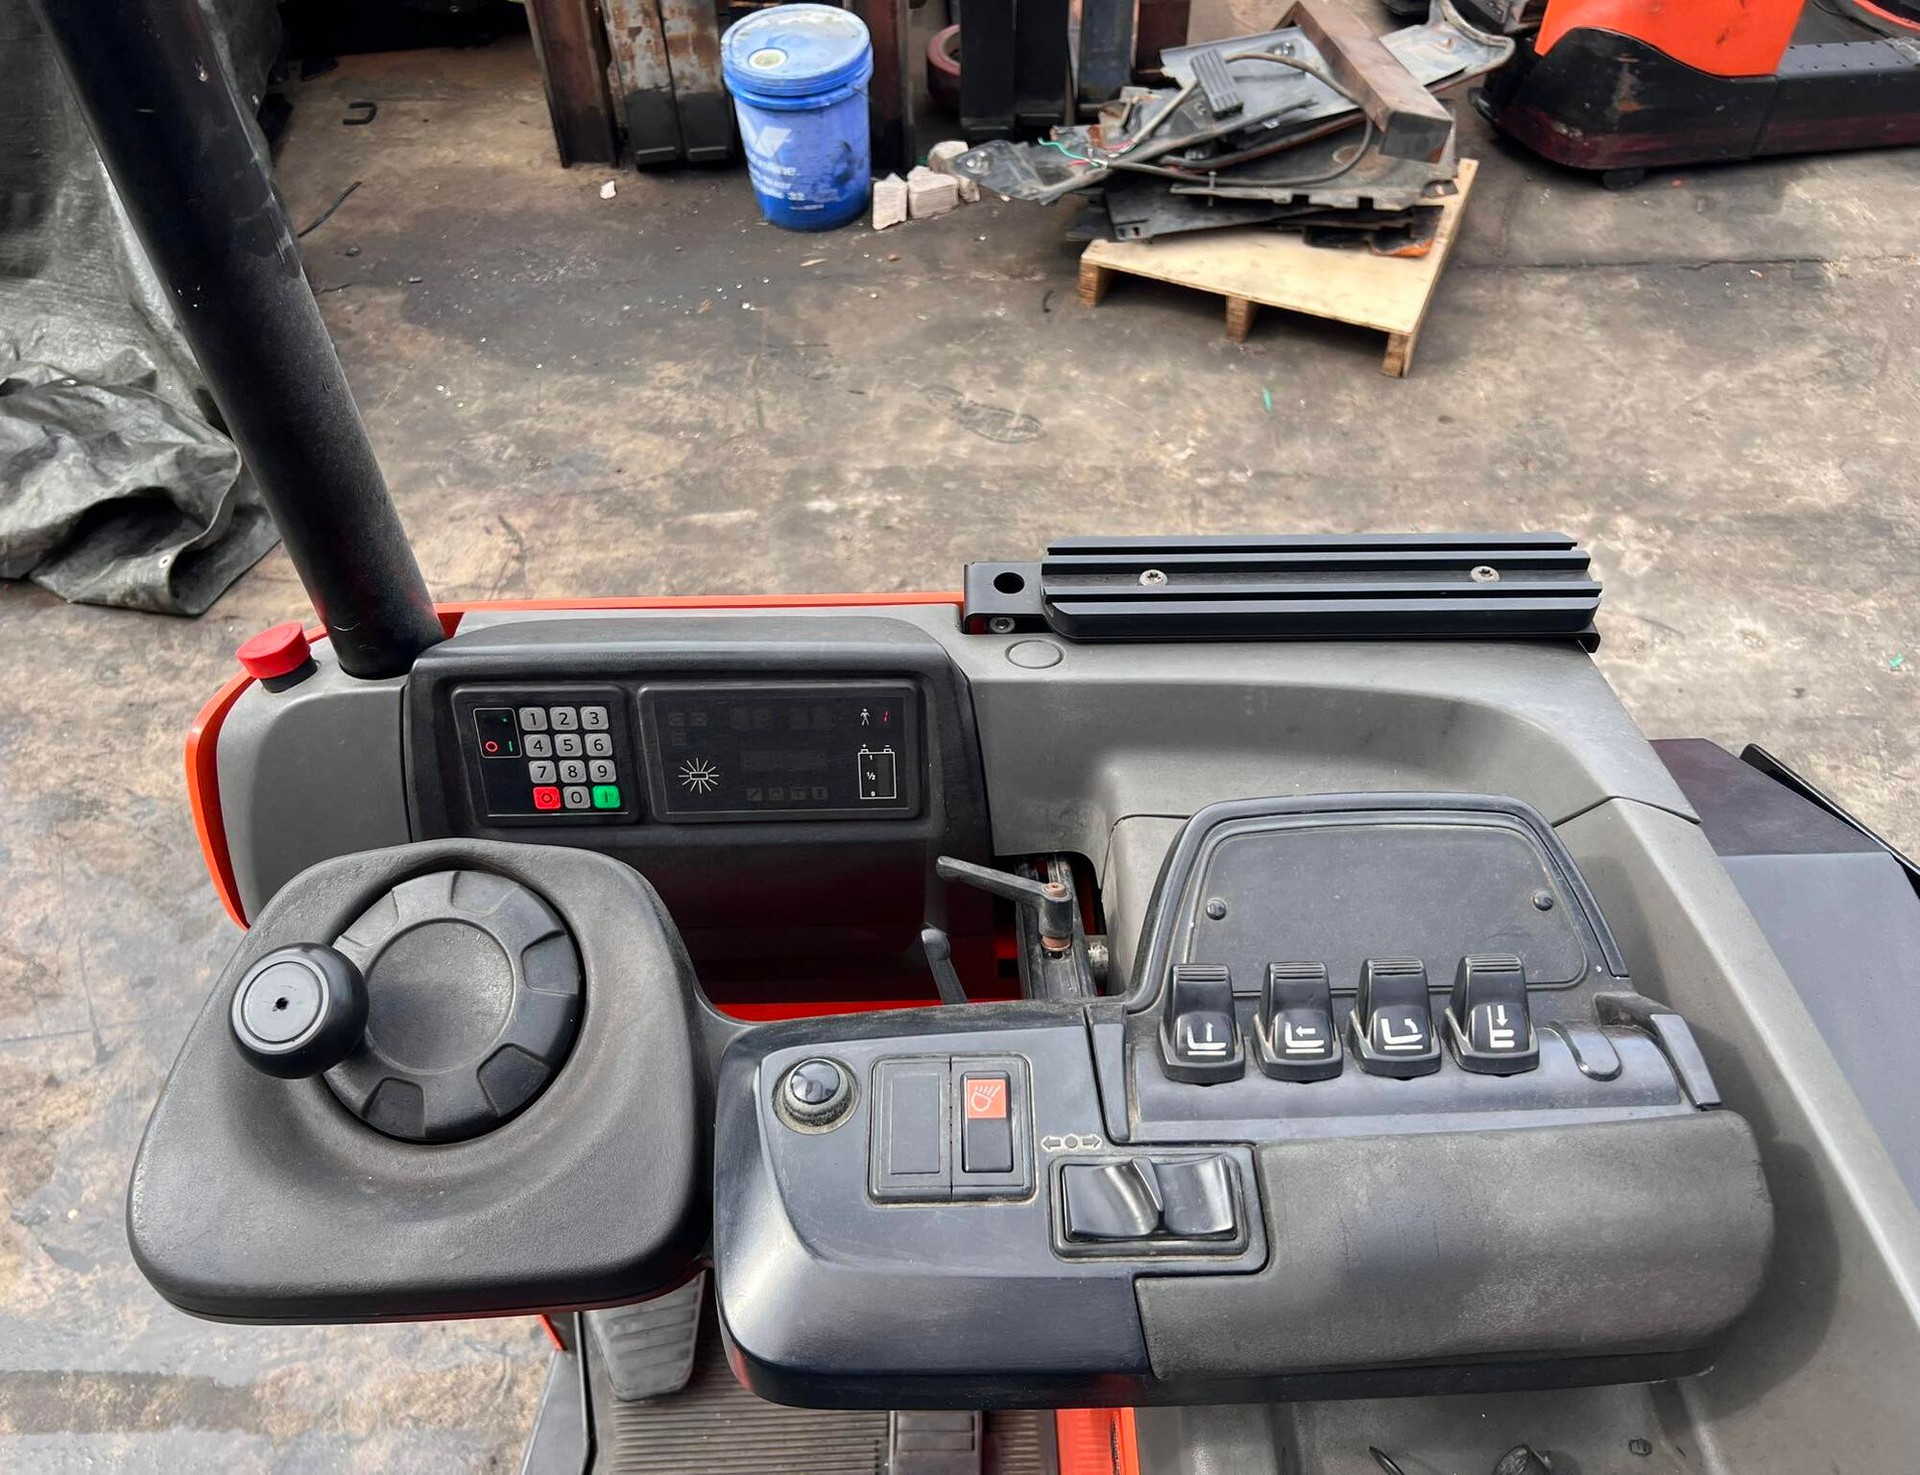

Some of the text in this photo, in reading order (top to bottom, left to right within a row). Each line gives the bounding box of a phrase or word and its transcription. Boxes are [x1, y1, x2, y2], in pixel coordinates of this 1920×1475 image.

[530, 712, 600, 726] 1 2 3
[534, 739, 604, 752] 4 5 6
[537, 766, 608, 778] 7 8 9
[571, 792, 582, 804] 0
